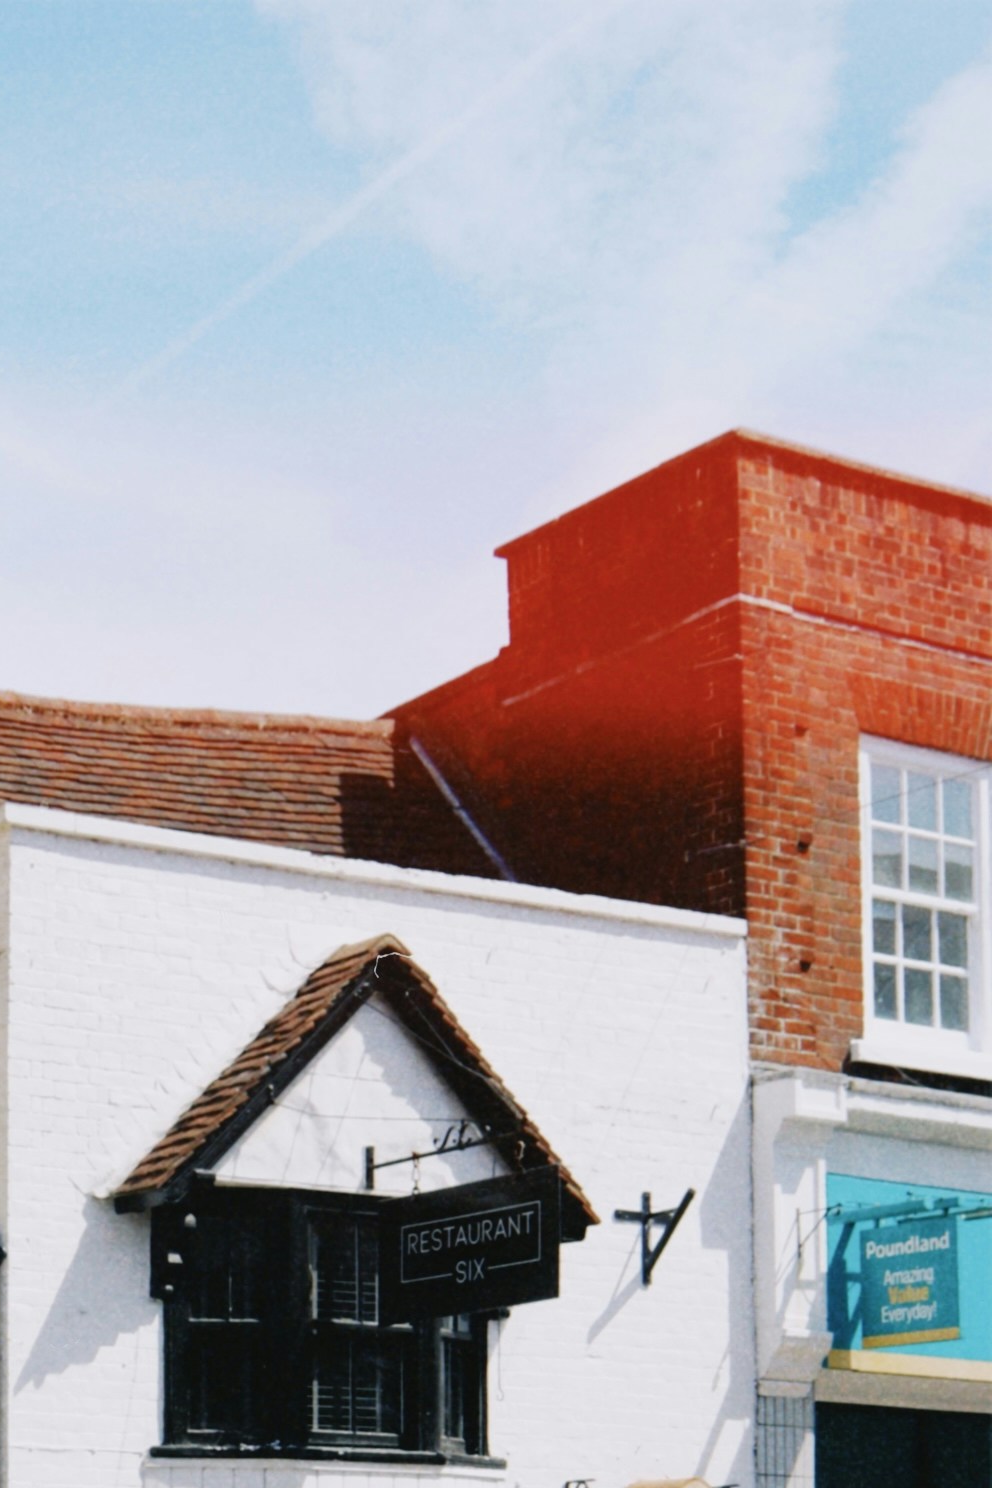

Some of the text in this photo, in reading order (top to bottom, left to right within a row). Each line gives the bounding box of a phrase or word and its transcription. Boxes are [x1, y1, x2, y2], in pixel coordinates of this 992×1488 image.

[407, 1210, 534, 1255] RESTAURANT
[866, 1231, 949, 1259] Poundland
[456, 1257, 485, 1284] SIX
[884, 1267, 934, 1286] Amazing
[888, 1285, 929, 1304] Value
